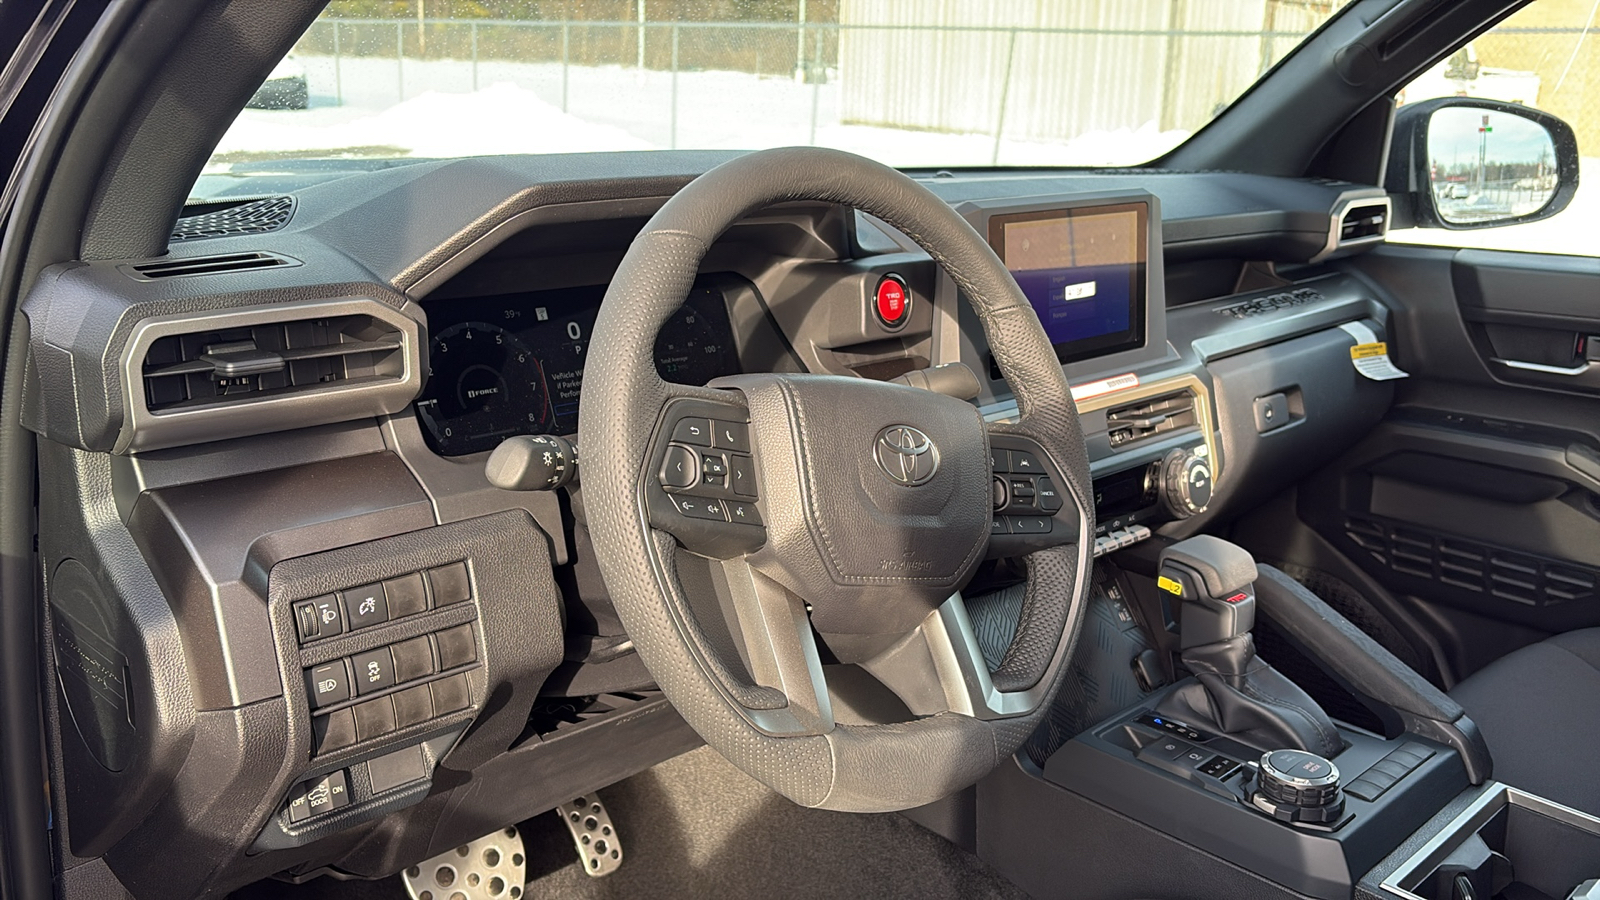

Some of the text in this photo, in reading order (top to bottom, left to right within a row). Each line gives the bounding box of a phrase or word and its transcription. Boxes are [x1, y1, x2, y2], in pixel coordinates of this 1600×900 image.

[685, 316, 695, 324] 80
[567, 321, 581, 340] 0
[466, 331, 472, 340] 4
[495, 335, 502, 344] 5
[441, 343, 448, 352] 3
[575, 345, 582, 355] P
[704, 345, 716, 354] 100
[518, 354, 525, 363] 6
[530, 382, 536, 391] 7
[528, 413, 535, 422] 8
[445, 428, 452, 437] 0
[369, 674, 381, 683] OFF
[332, 786, 344, 795] ON
[292, 796, 305, 808] OFF
[310, 797, 329, 808] DOOR
